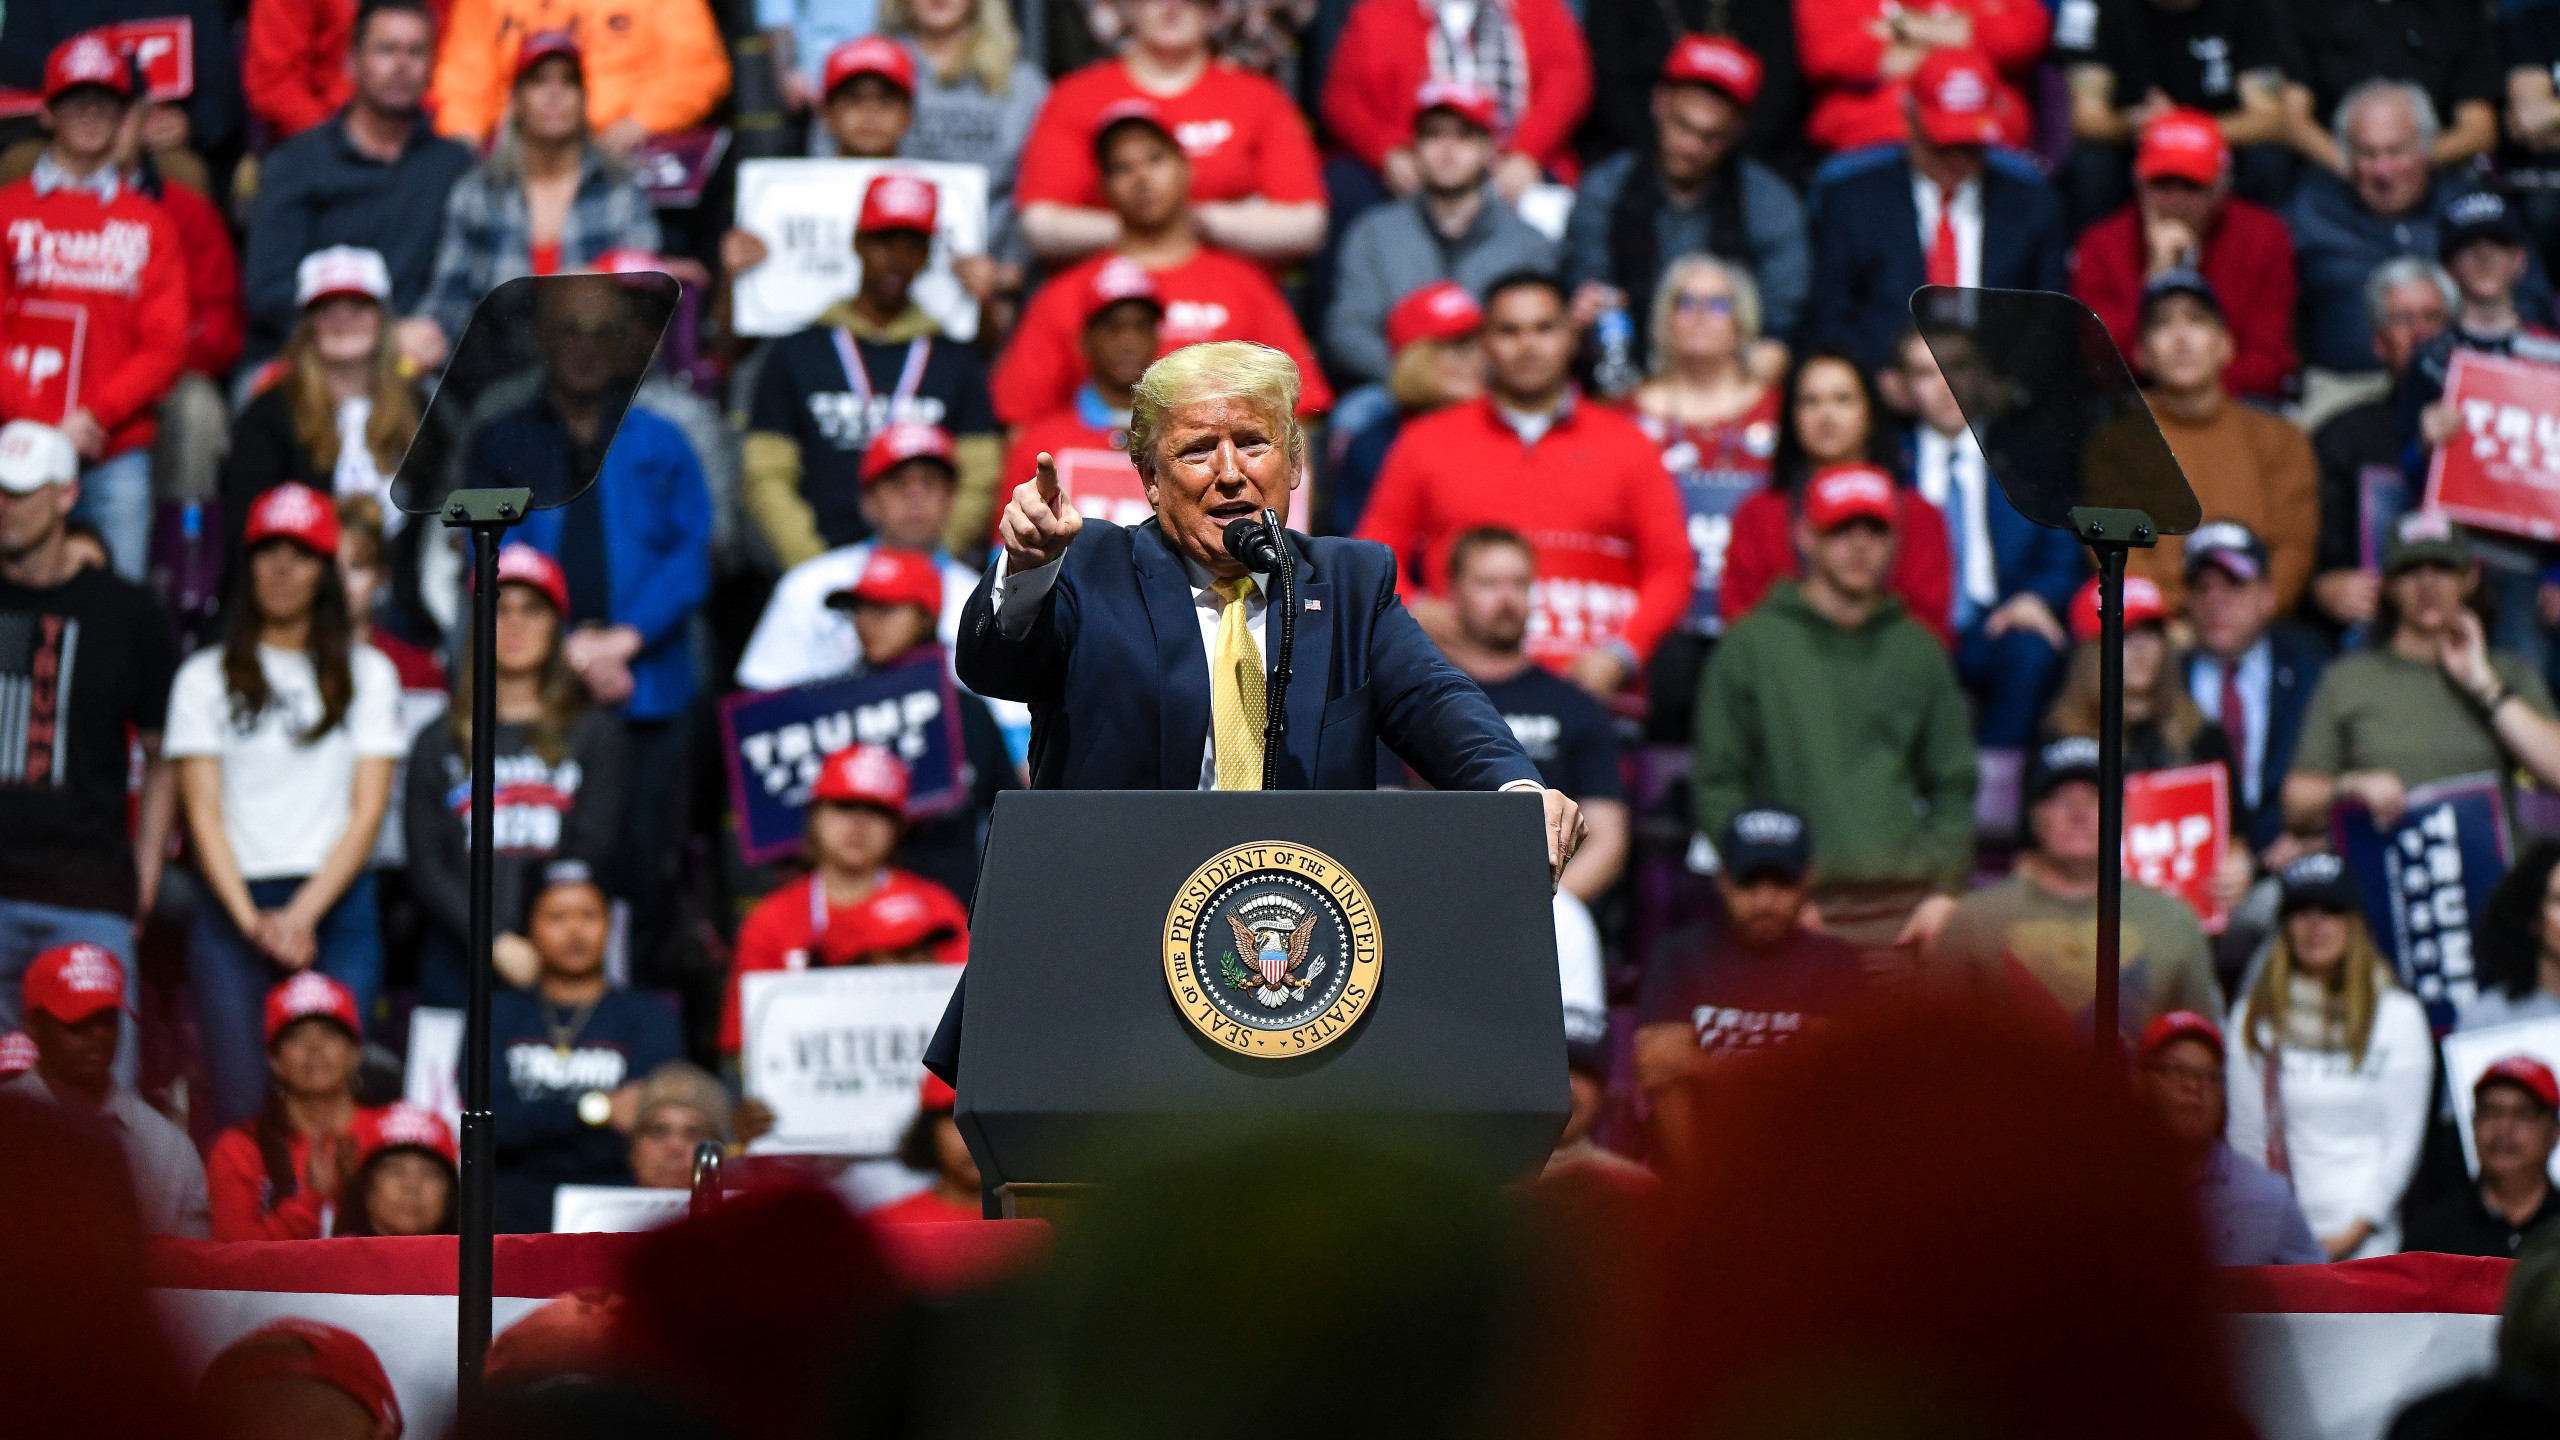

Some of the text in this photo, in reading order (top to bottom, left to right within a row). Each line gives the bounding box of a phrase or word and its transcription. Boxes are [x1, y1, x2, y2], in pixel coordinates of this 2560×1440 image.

[739, 689, 942, 774] TRUMP
[1171, 849, 1375, 1049] SEAL OF THE PRESIDENT OF THE UNITED STATES
